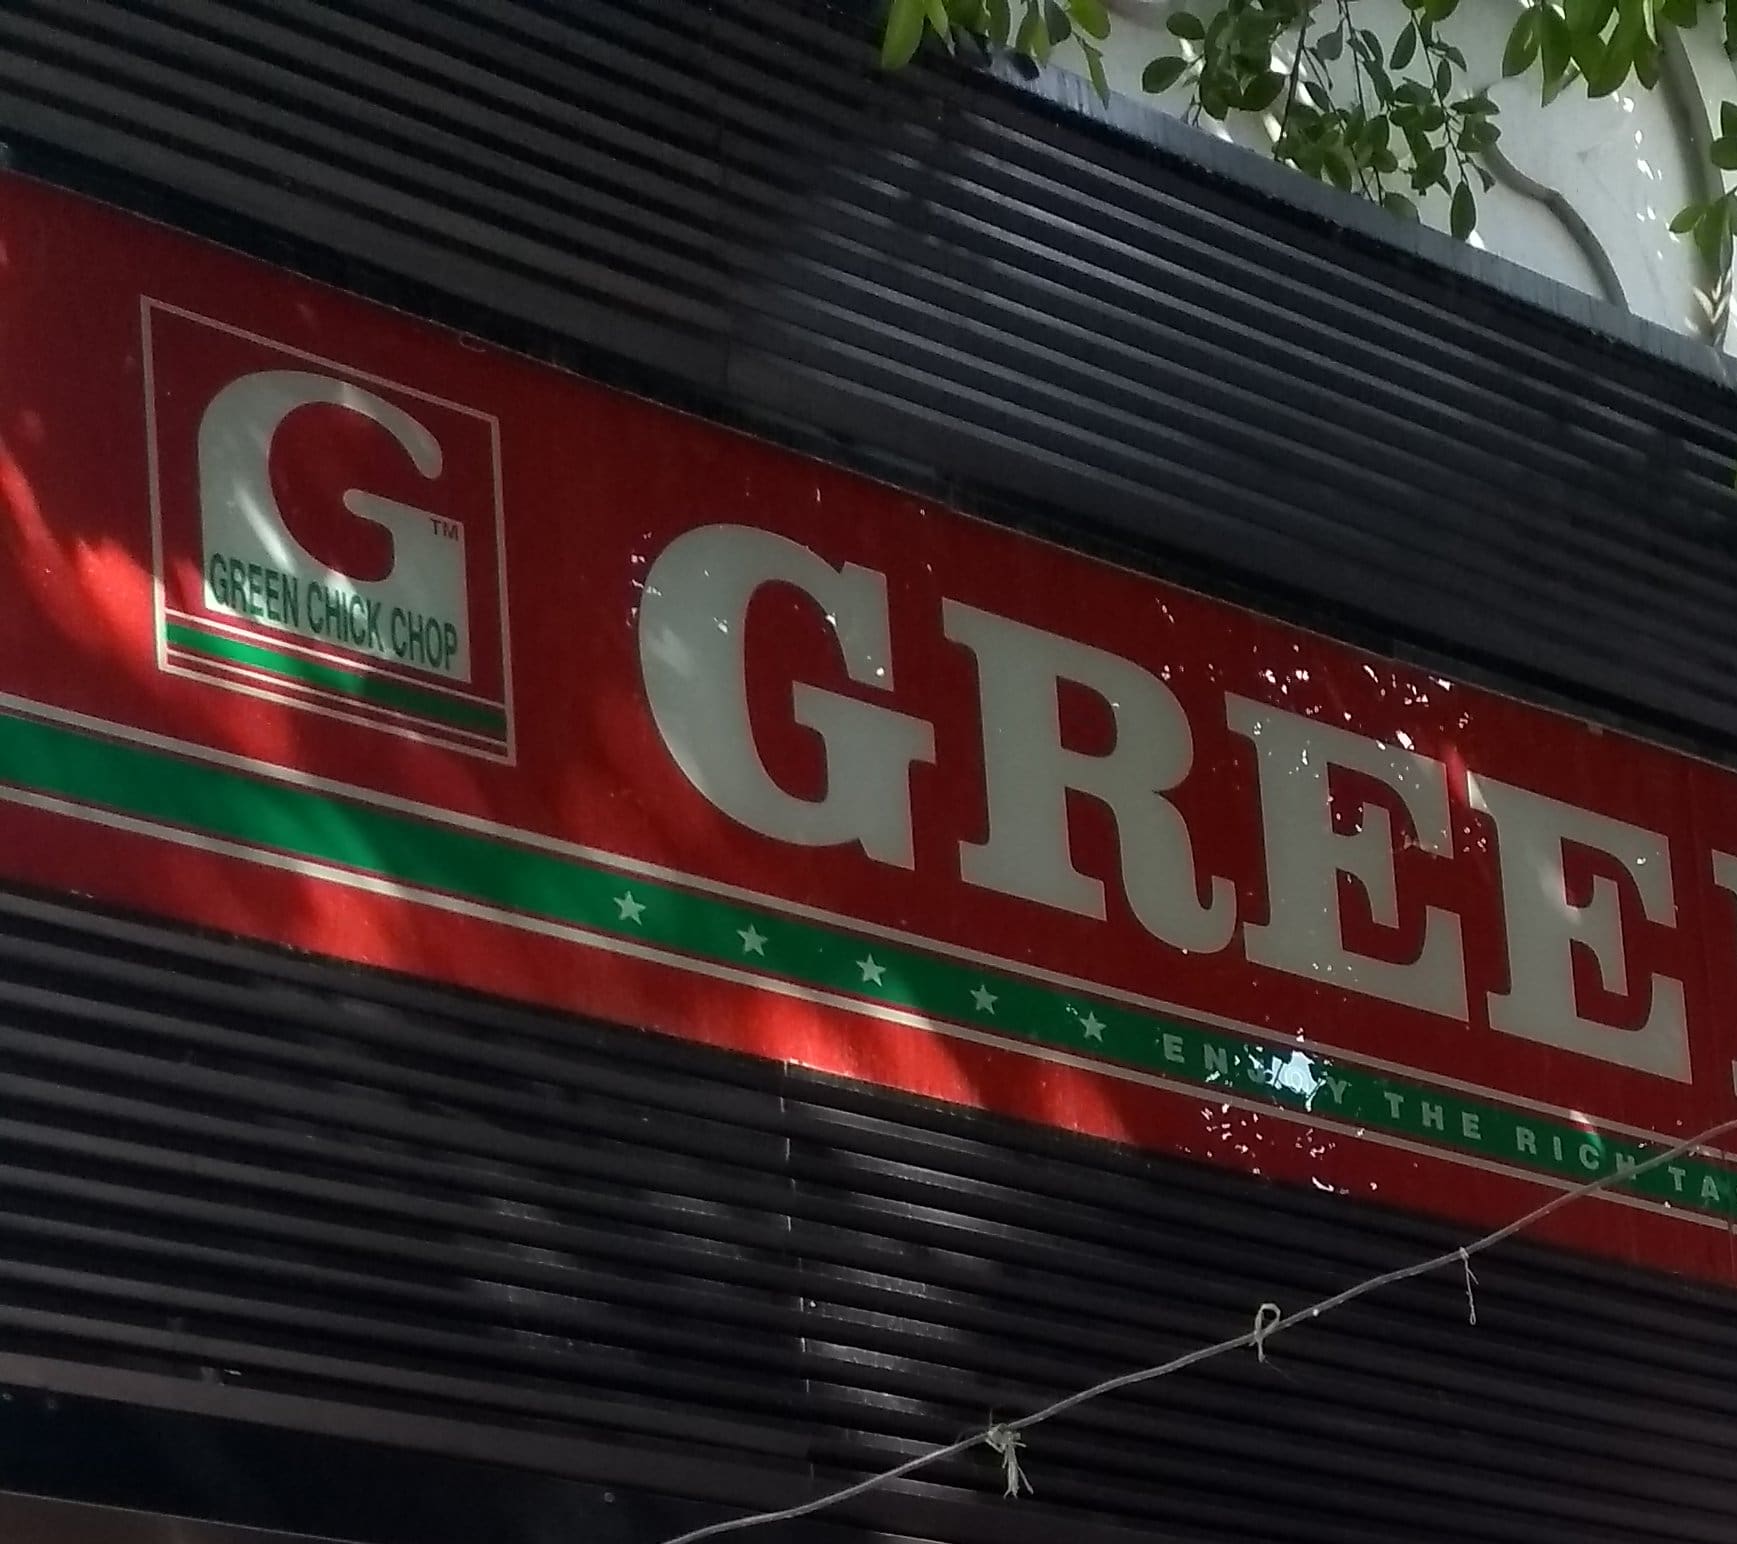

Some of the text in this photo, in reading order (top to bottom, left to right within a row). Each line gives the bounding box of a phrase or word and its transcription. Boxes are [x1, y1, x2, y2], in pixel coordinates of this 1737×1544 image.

[198, 369, 470, 684] G
[430, 517, 460, 542] TM
[209, 552, 458, 672] GREEN CHICK CHOP
[1384, 1091, 1481, 1141] THE
[1516, 1127, 1636, 1181] RICH
